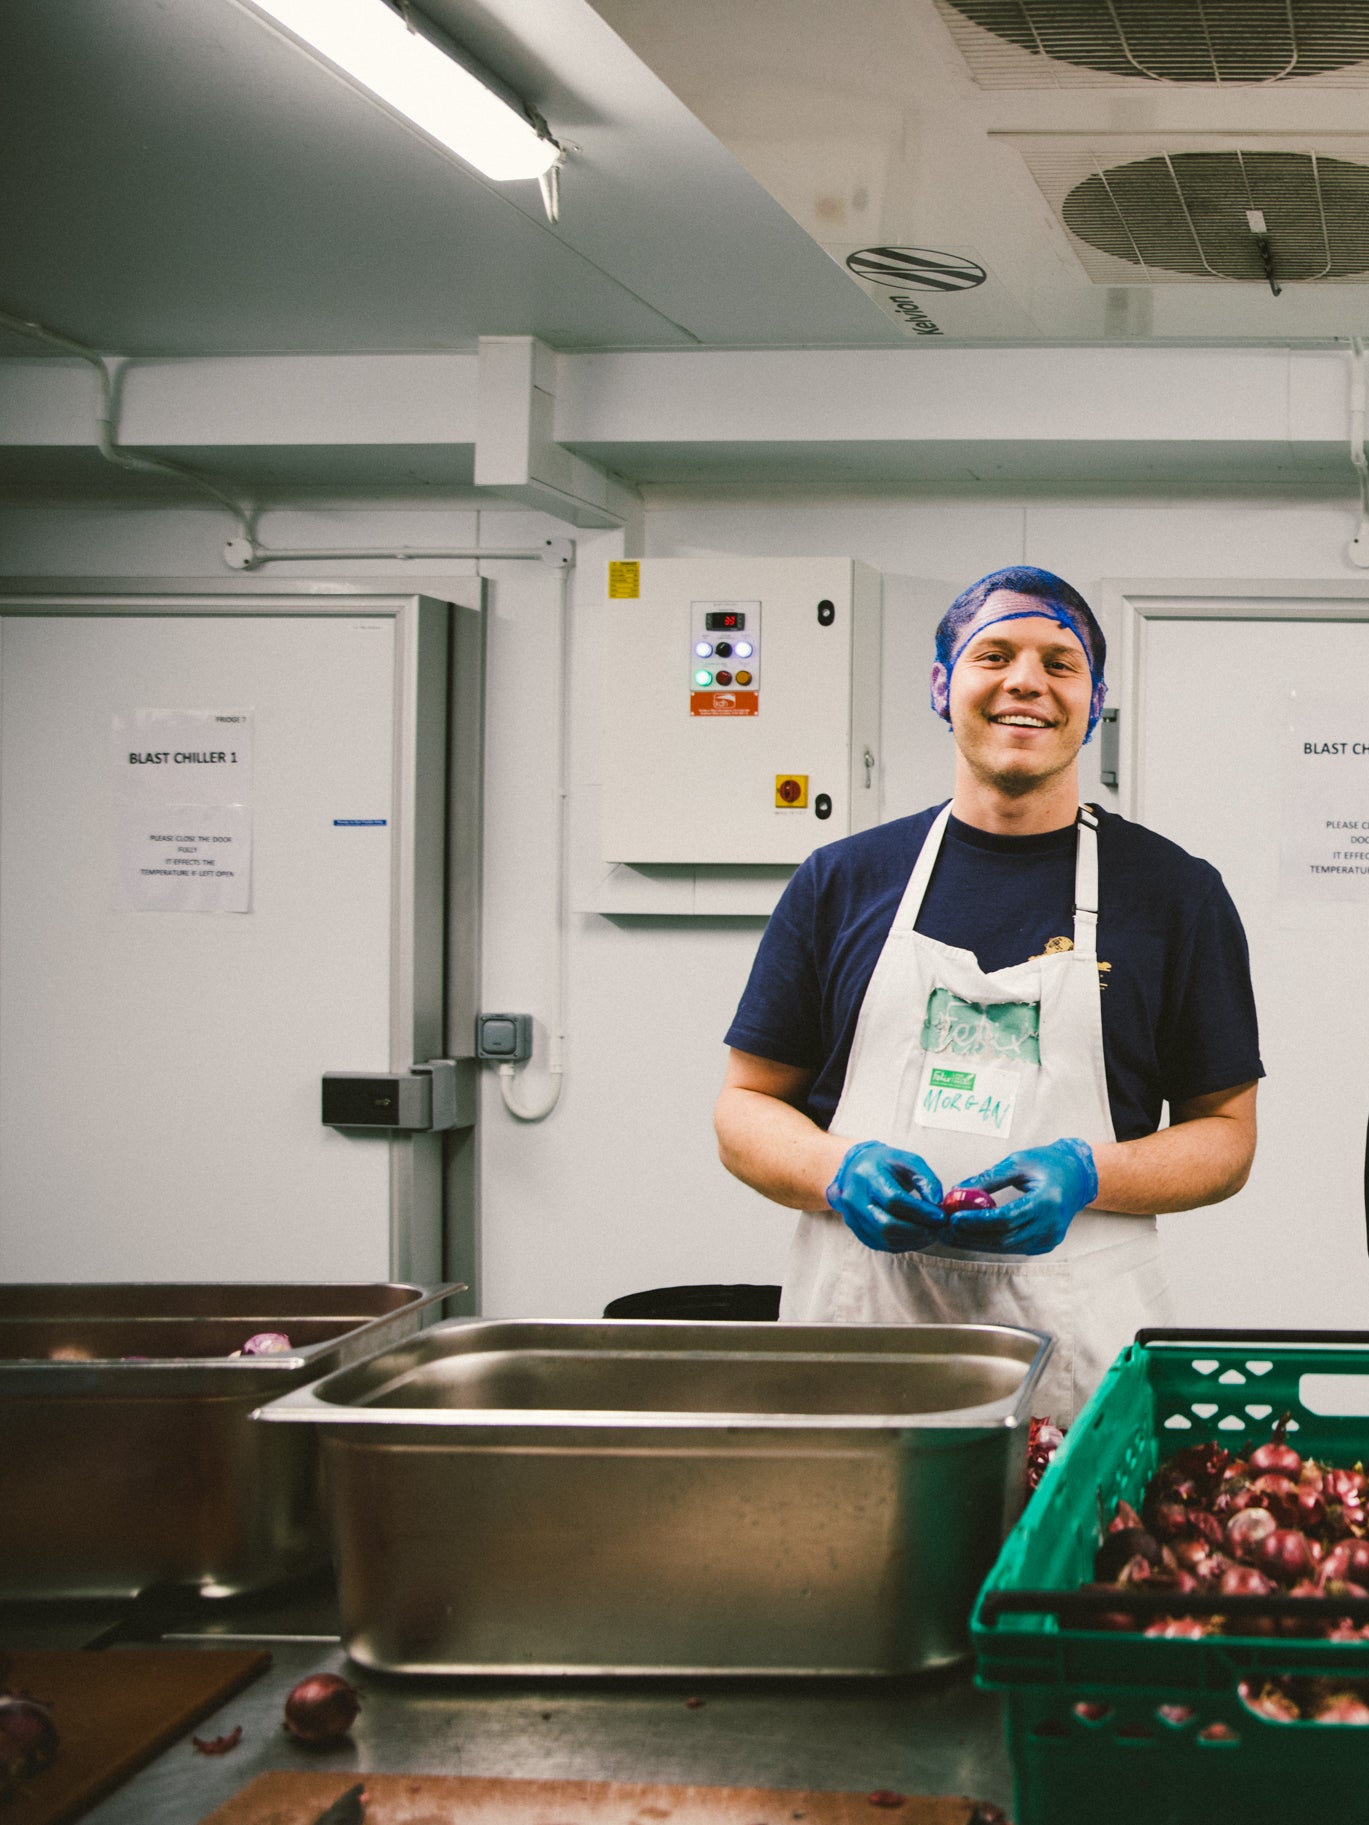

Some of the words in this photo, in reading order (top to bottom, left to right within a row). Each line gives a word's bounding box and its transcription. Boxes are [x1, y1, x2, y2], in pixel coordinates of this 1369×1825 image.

[889, 295, 944, 335] Kelvion
[1304, 742, 1347, 755] BLAST
[129, 752, 170, 764] BLAST
[174, 752, 226, 763] CHILLER
[231, 752, 238, 763] 1
[1326, 821, 1359, 829] PLEASE
[1333, 851, 1341, 859] IT
[923, 1088, 1010, 1129] MORGAN
